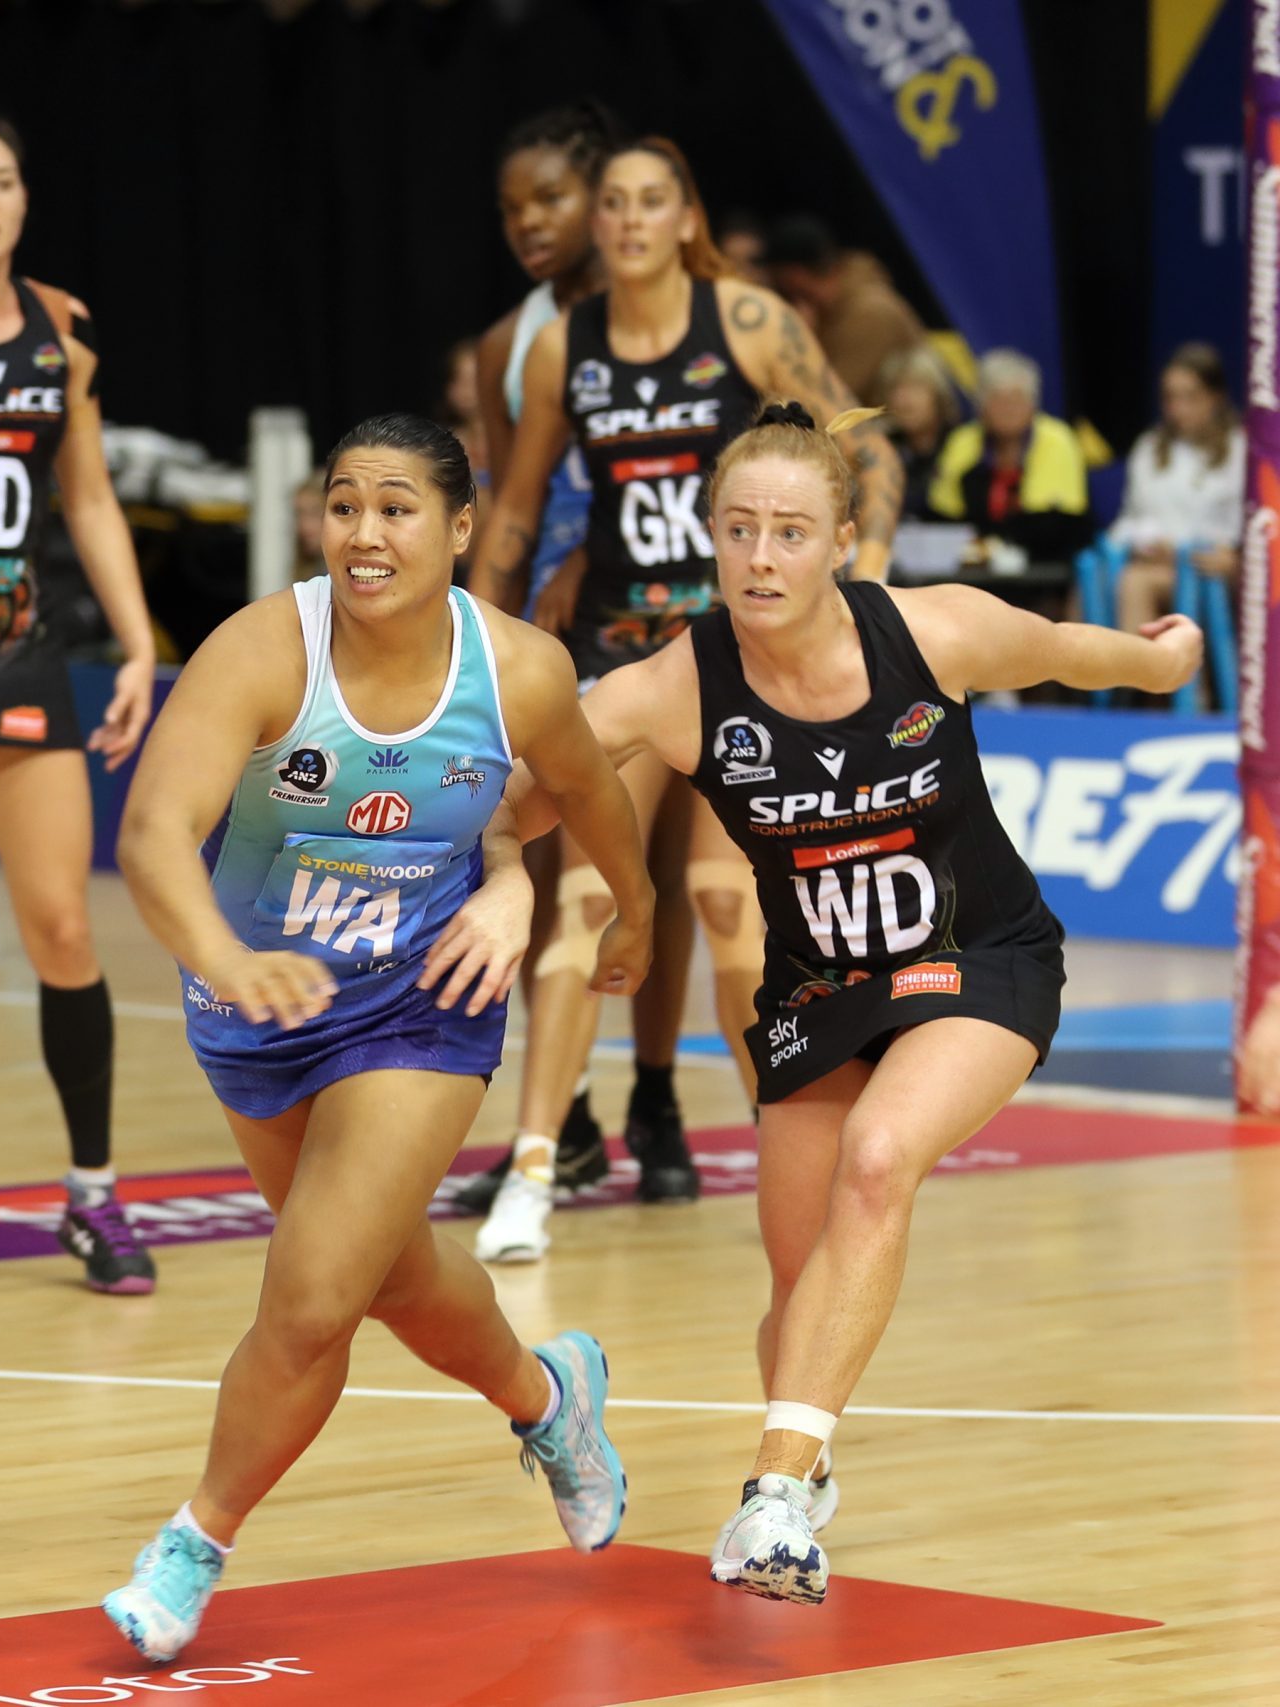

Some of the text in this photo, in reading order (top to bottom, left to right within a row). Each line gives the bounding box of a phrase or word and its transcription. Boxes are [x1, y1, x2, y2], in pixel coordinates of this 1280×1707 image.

[620, 474, 715, 567] GK
[729, 746, 758, 759] ANZ
[287, 770, 320, 785] ANZ
[441, 771, 485, 788] MYSTICS
[270, 788, 327, 806] PREMIERSHIP
[351, 794, 407, 834] MG
[748, 803, 904, 837] CONSTRUCTION
[297, 853, 436, 880] STONEWOOD
[282, 868, 401, 957] WA
[789, 854, 937, 958] WD
[895, 972, 957, 988] CHEMIST
[187, 985, 234, 1018] SPORT
[768, 1016, 799, 1048] sky
[770, 1036, 809, 1068] SPORT
